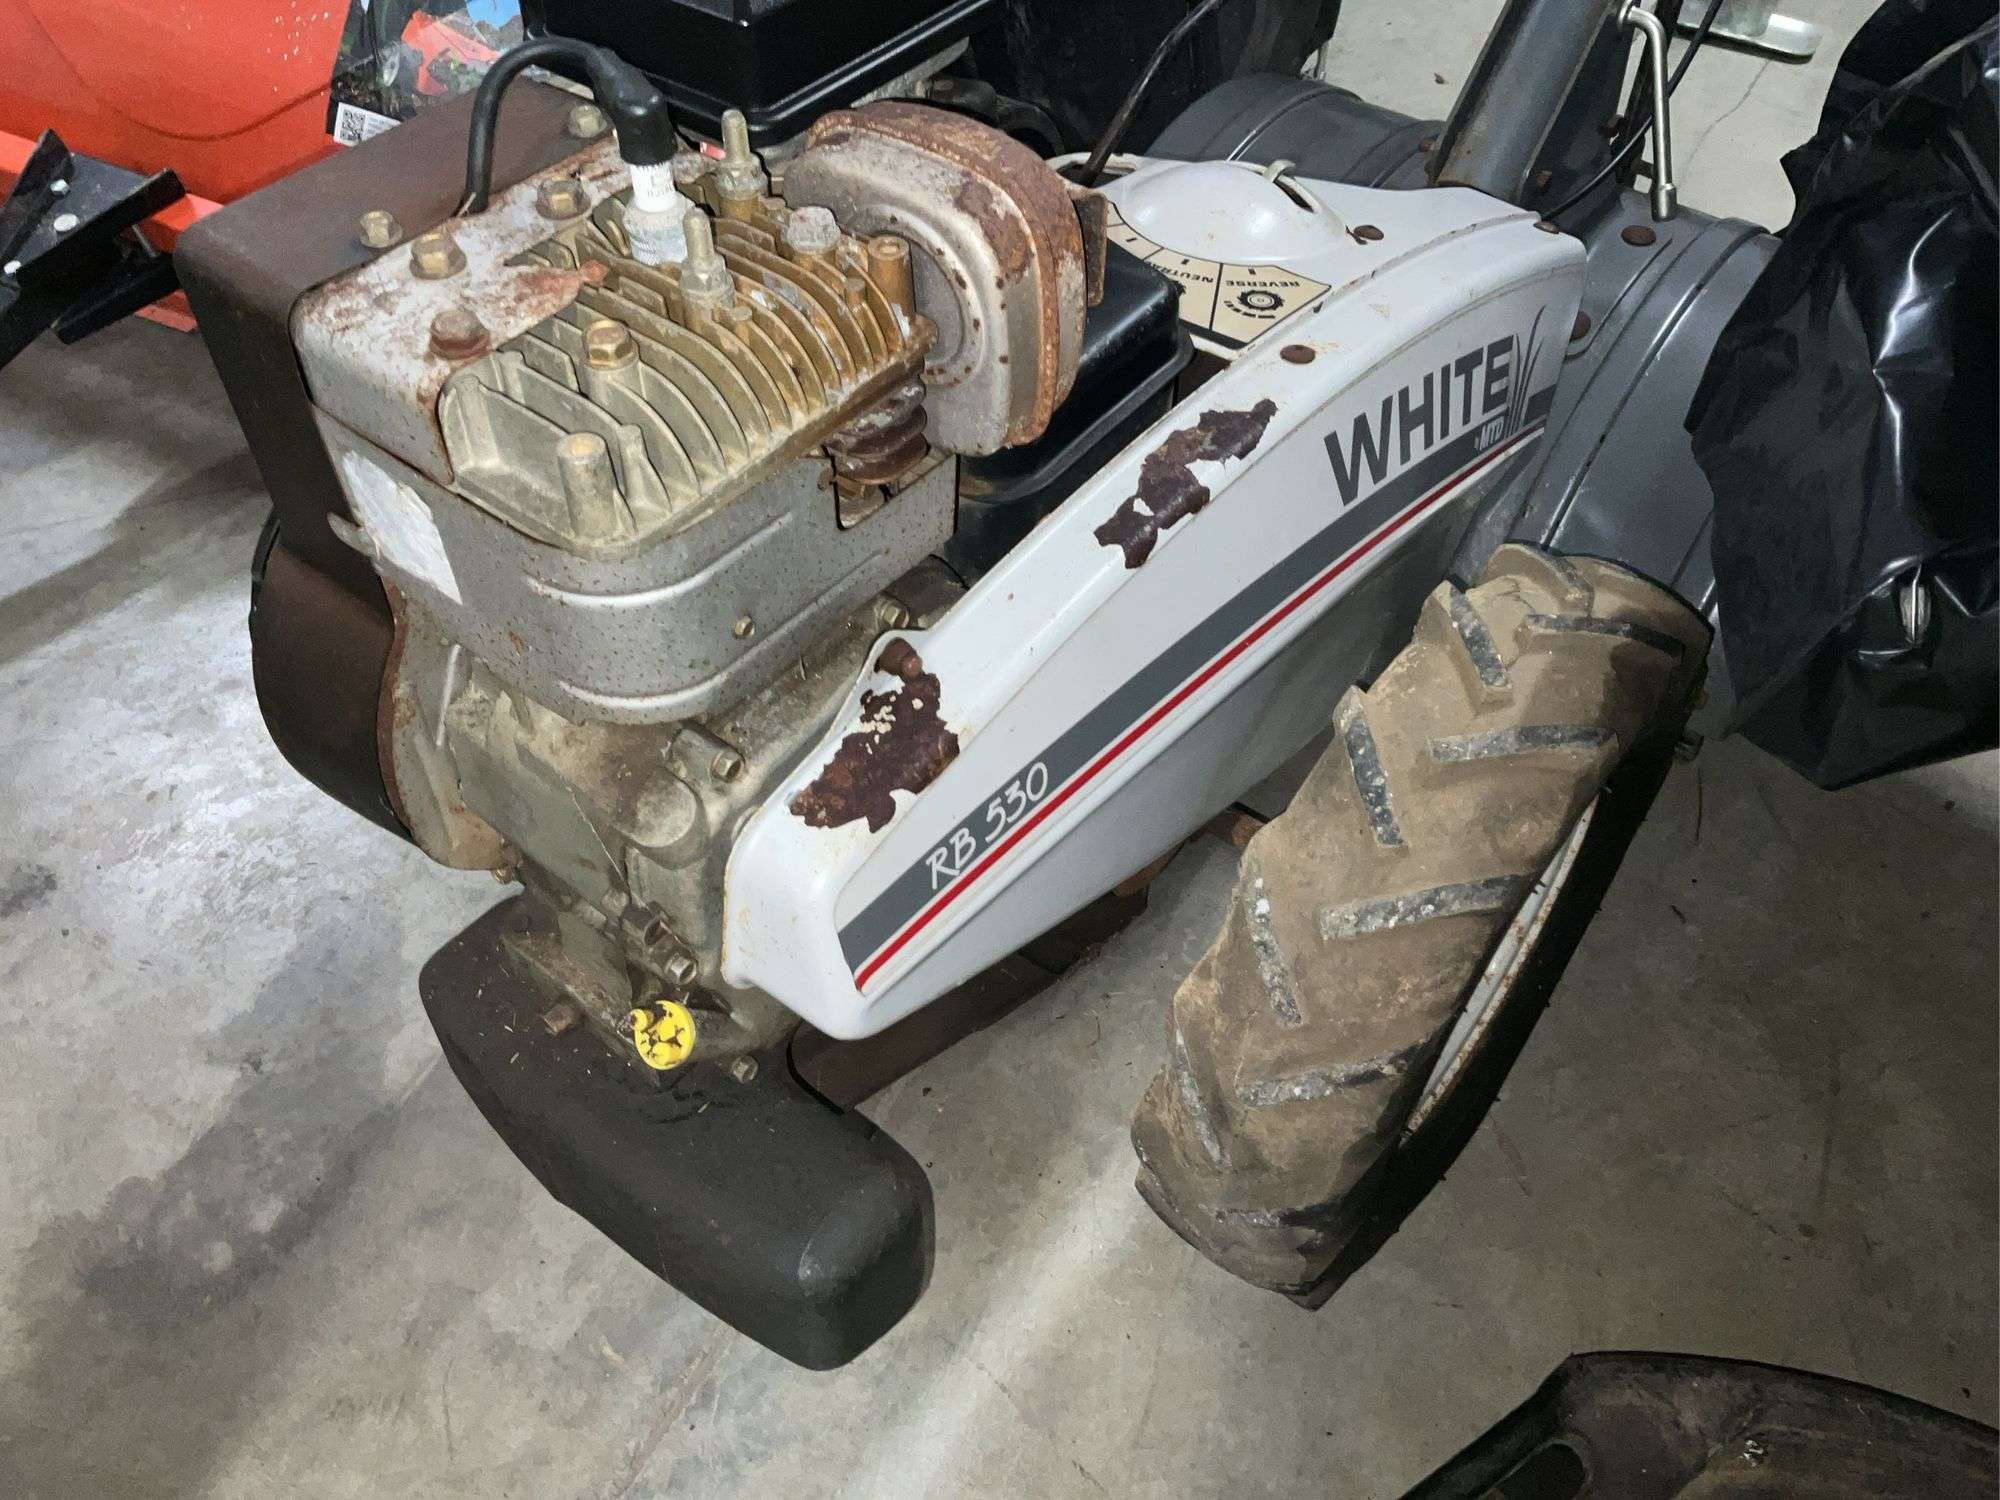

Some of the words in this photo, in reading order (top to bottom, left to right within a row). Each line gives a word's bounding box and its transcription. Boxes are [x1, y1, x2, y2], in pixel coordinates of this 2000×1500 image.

[1148, 262, 1214, 284] NEUTRA
[1225, 280, 1300, 288] REVERSE
[1324, 335, 1514, 507] WHITE
[926, 828, 976, 889] RB
[985, 762, 1048, 843] 530
